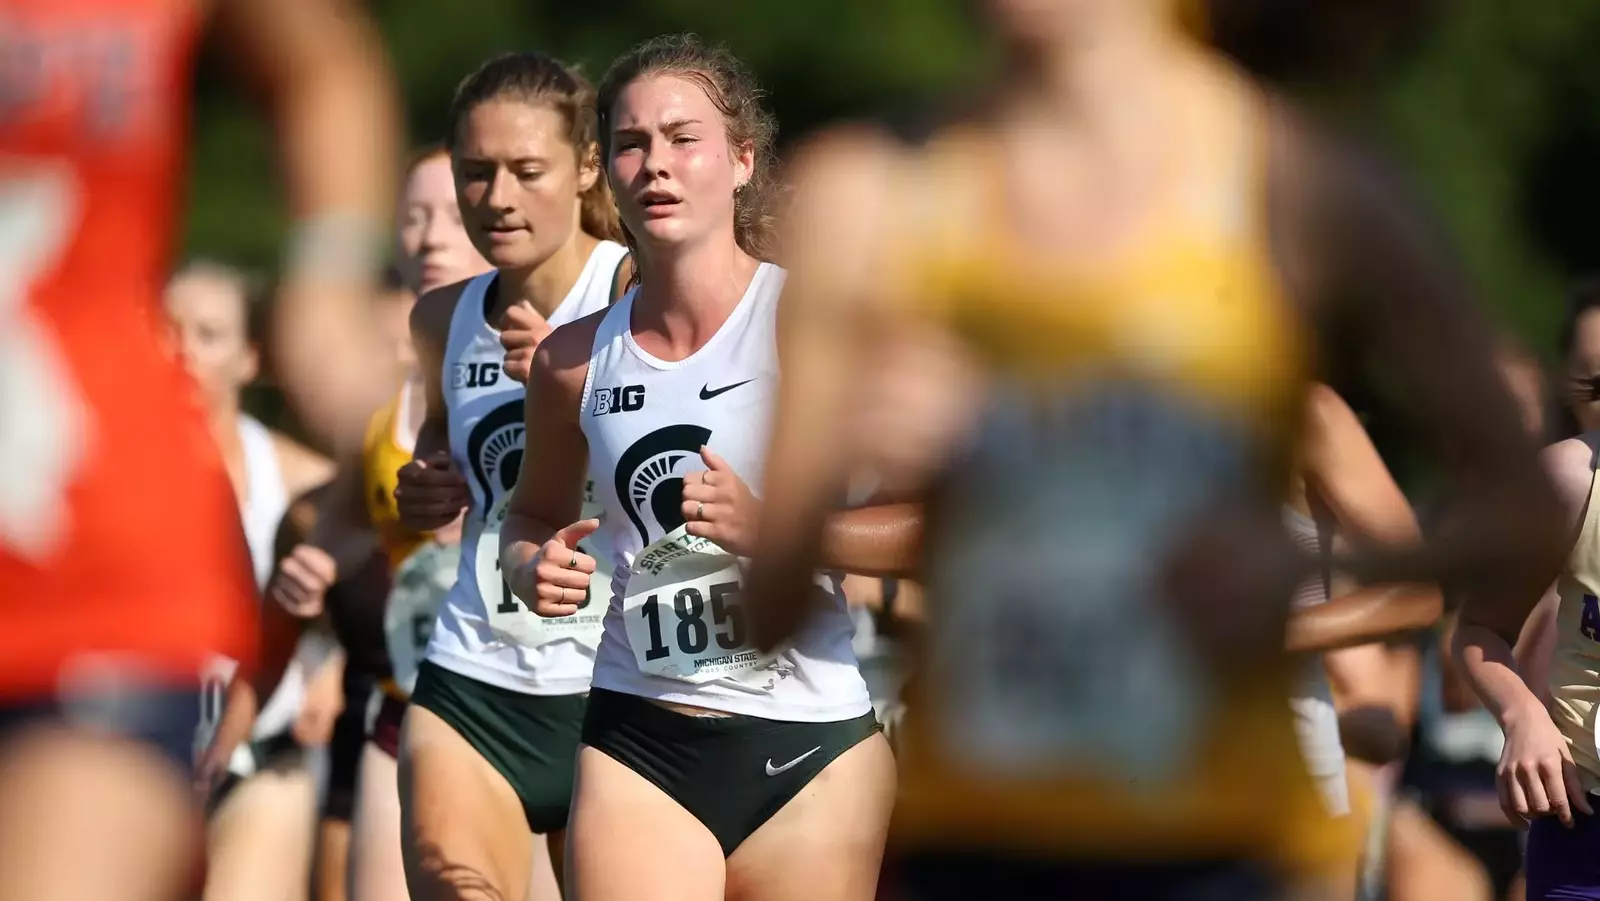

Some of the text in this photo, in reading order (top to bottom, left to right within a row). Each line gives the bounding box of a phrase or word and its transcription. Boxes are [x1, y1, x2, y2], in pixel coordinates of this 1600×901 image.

[640, 533, 706, 571] SPART
[641, 581, 746, 661] 185
[693, 651, 757, 668] MICHIGAN STATE
[723, 661, 758, 671] COUNTRY
